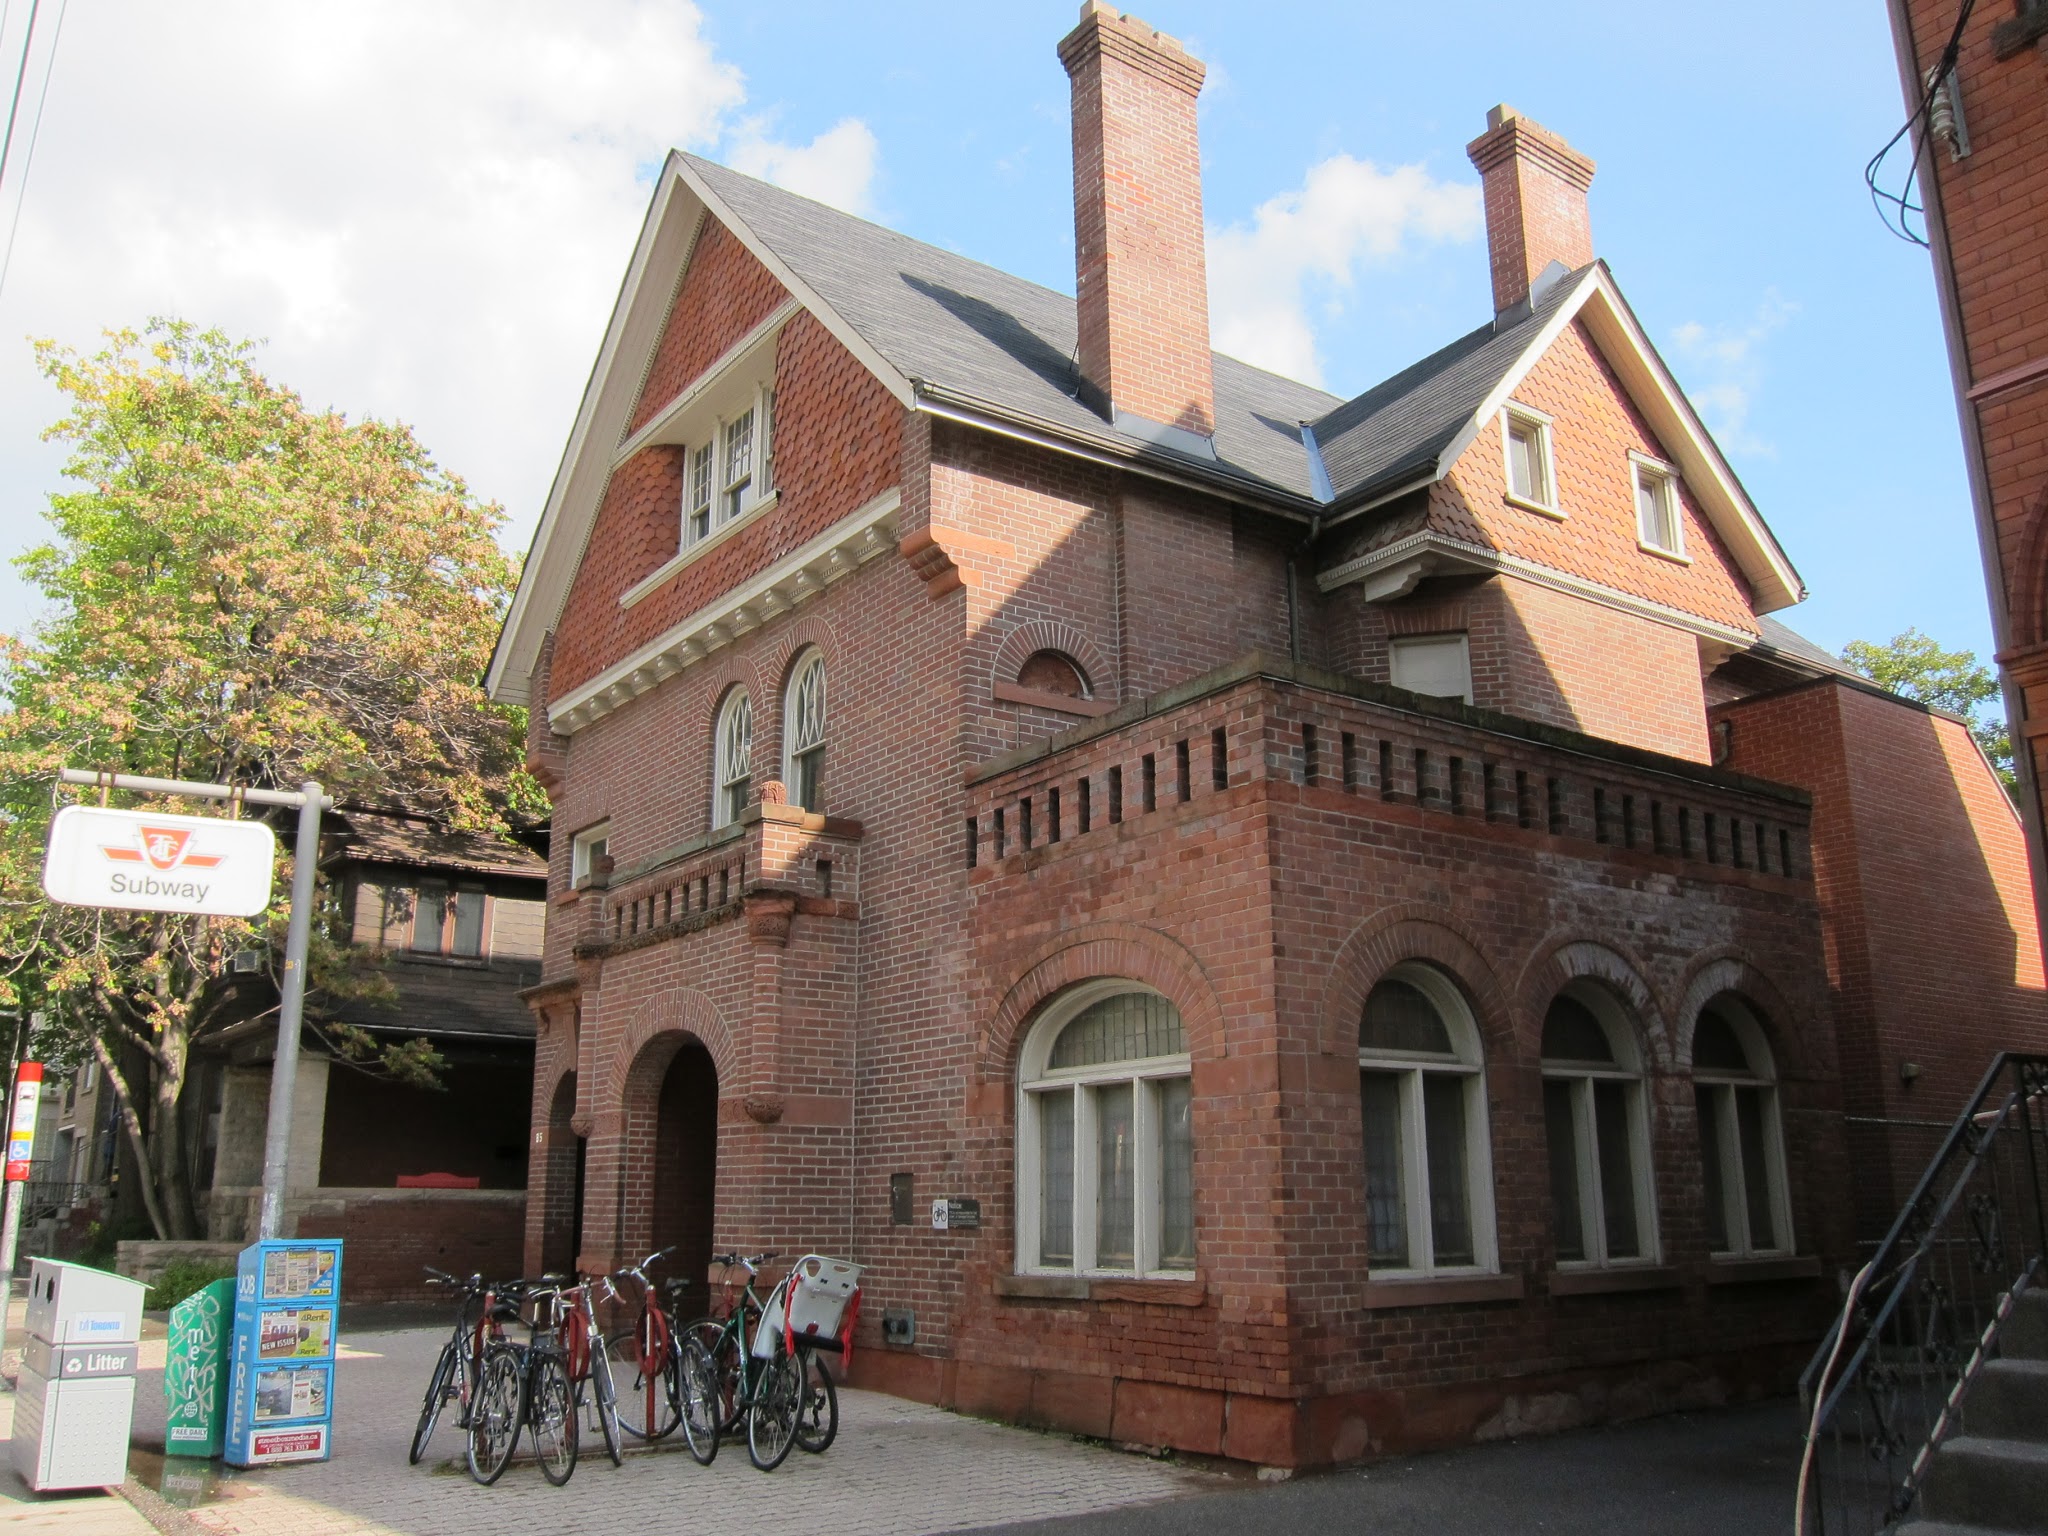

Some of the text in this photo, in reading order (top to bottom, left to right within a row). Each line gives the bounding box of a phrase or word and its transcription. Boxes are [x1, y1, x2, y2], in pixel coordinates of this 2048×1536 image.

[110, 873, 210, 904] Subway
[238, 1274, 256, 1295] JOB
[261, 1336, 295, 1351] NEW ISSUE
[87, 1353, 128, 1372] Litter
[231, 1334, 248, 1445] FREE
[172, 1428, 207, 1436] FREE DAILY
